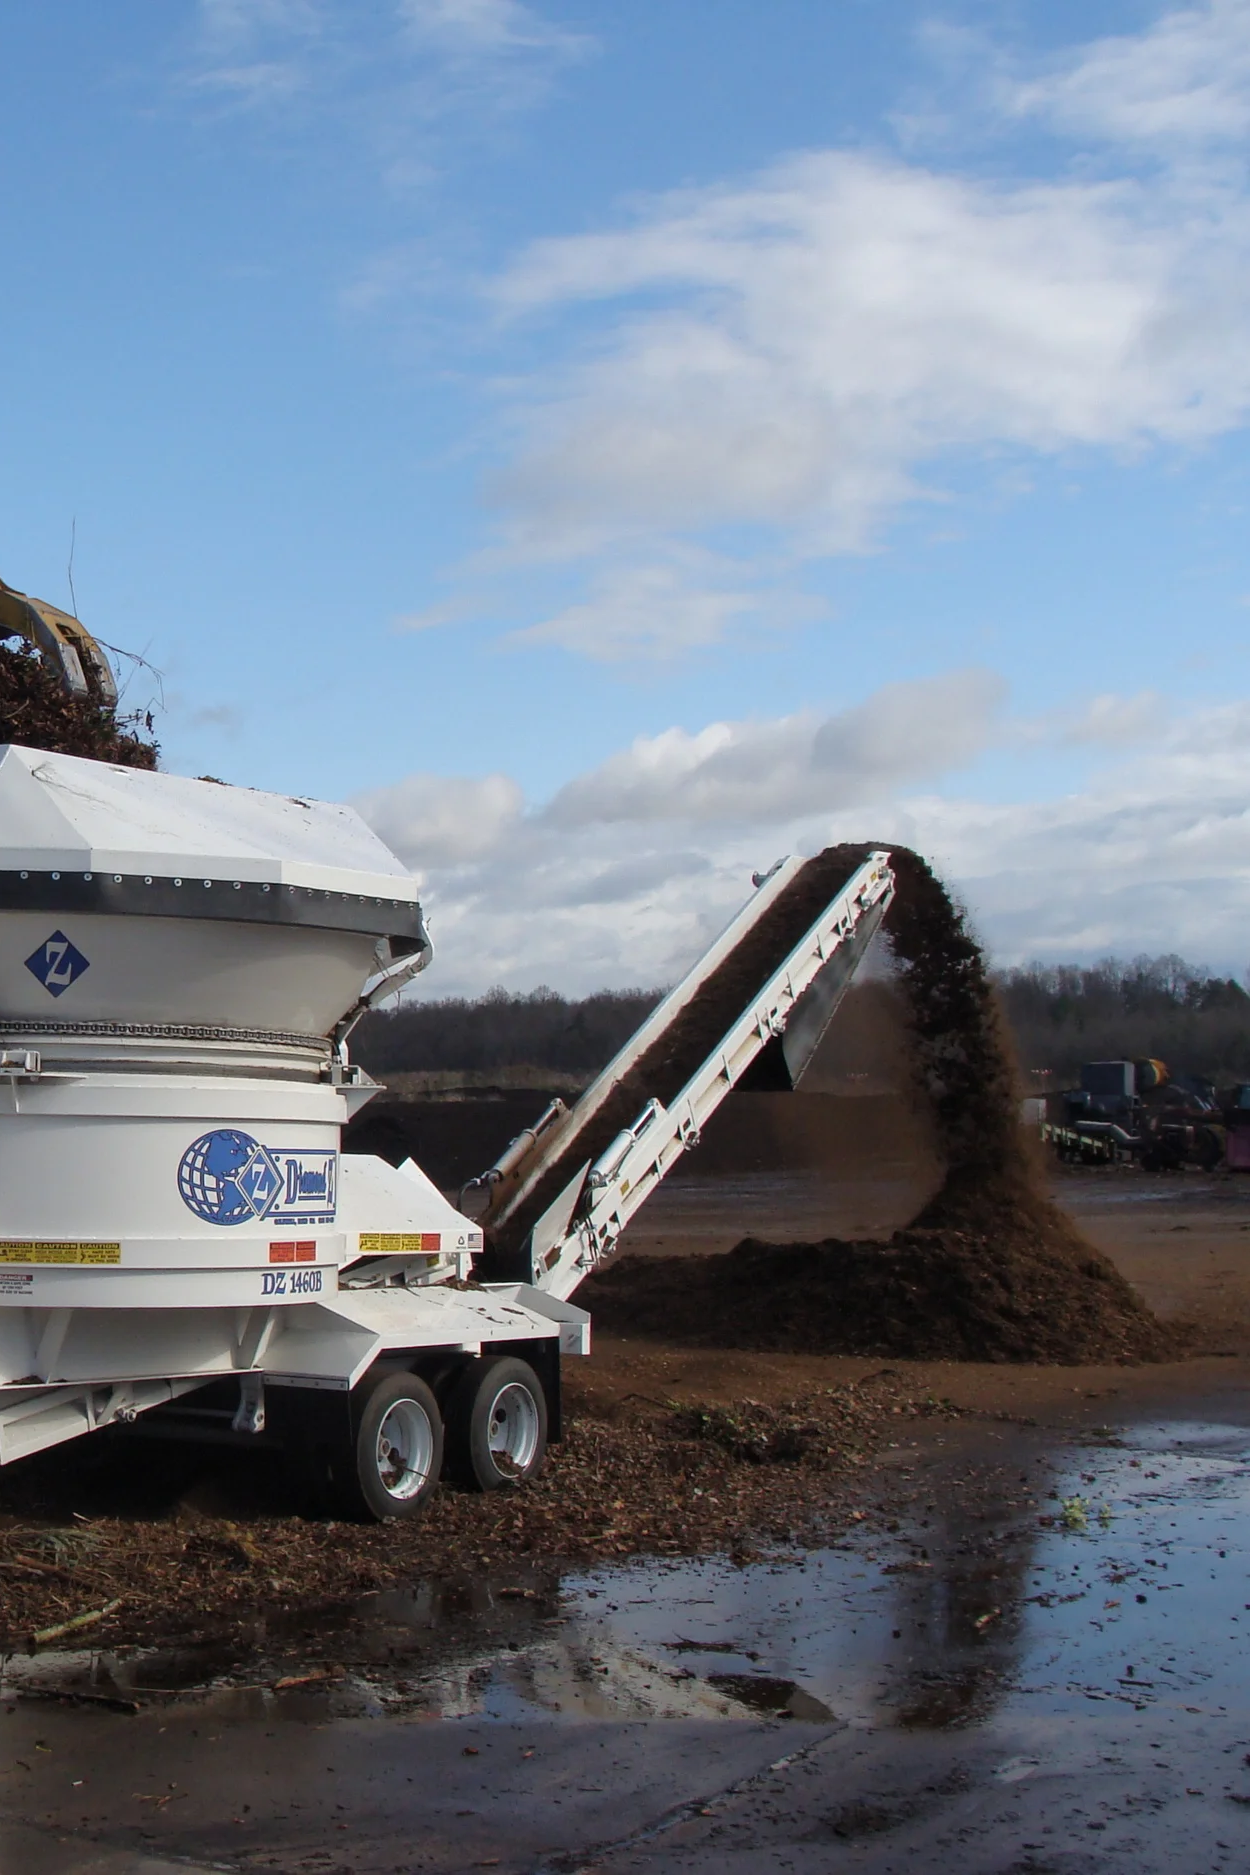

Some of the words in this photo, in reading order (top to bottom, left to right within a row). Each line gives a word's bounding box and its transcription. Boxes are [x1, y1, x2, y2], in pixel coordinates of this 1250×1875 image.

[45, 941, 72, 986] Z
[251, 1163, 269, 1200] Z
[261, 1272, 286, 1295] DZ
[289, 1270, 323, 1294] 1460B
